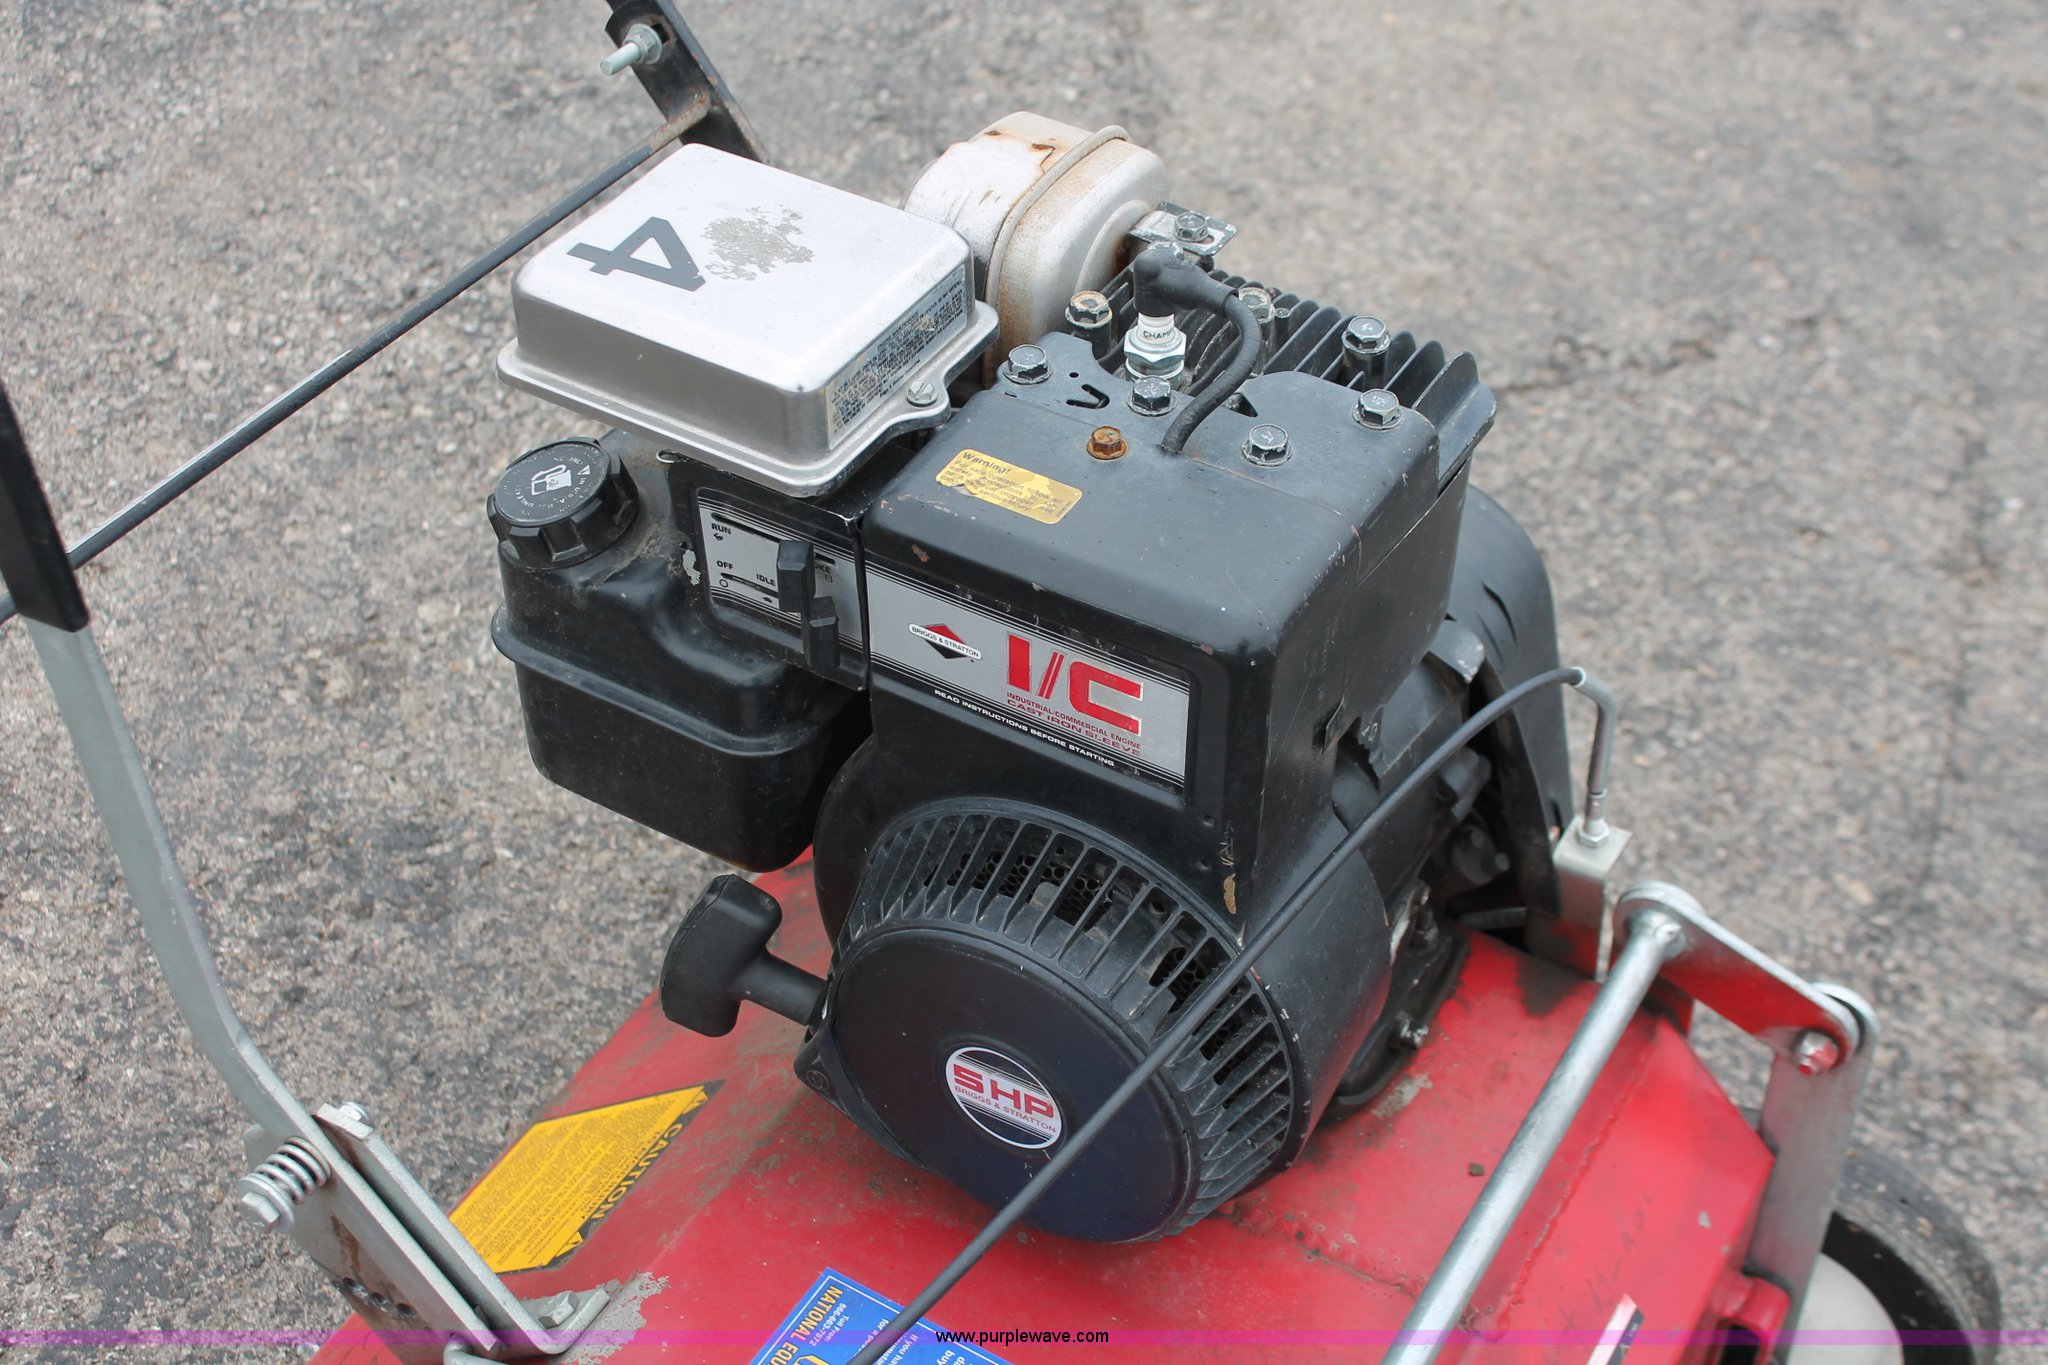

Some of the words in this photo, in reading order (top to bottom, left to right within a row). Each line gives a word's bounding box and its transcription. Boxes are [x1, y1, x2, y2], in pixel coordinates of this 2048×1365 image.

[566, 216, 706, 292] 4
[962, 452, 1012, 474] Warning!
[988, 472, 1024, 490] operation
[711, 523, 731, 535] RUN
[716, 560, 734, 570] OFF
[756, 573, 776, 587] IDLE
[911, 626, 938, 643] BRIGGS
[938, 636, 944, 644] &
[944, 639, 980, 658] STRATTON
[934, 689, 960, 704] READ
[962, 700, 1028, 732] INSTRUCTIONS
[1030, 728, 1066, 748] BEFORE
[1069, 743, 1115, 767] STARTING
[1006, 692, 1109, 738] INDUSTRIAL/COMMERCIAL
[1110, 732, 1141, 750] ENGINE
[1006, 700, 1044, 718] CAST
[1047, 714, 1082, 734] IRON
[1084, 730, 1141, 757] SLEEVE
[955, 1085, 991, 1106] BRIGGS
[993, 1101, 1001, 1110] &
[1003, 1106, 1056, 1134] STRATTON
[591, 1122, 685, 1220] CAUTION
[790, 1285, 844, 1341] NATIONAL
[837, 1315, 850, 1328] Toll
[824, 1327, 840, 1343] Free:
[877, 1318, 889, 1331] for
[899, 1340, 912, 1355] you
[911, 1334, 919, 1343] If
[767, 1341, 799, 1365] EQU
